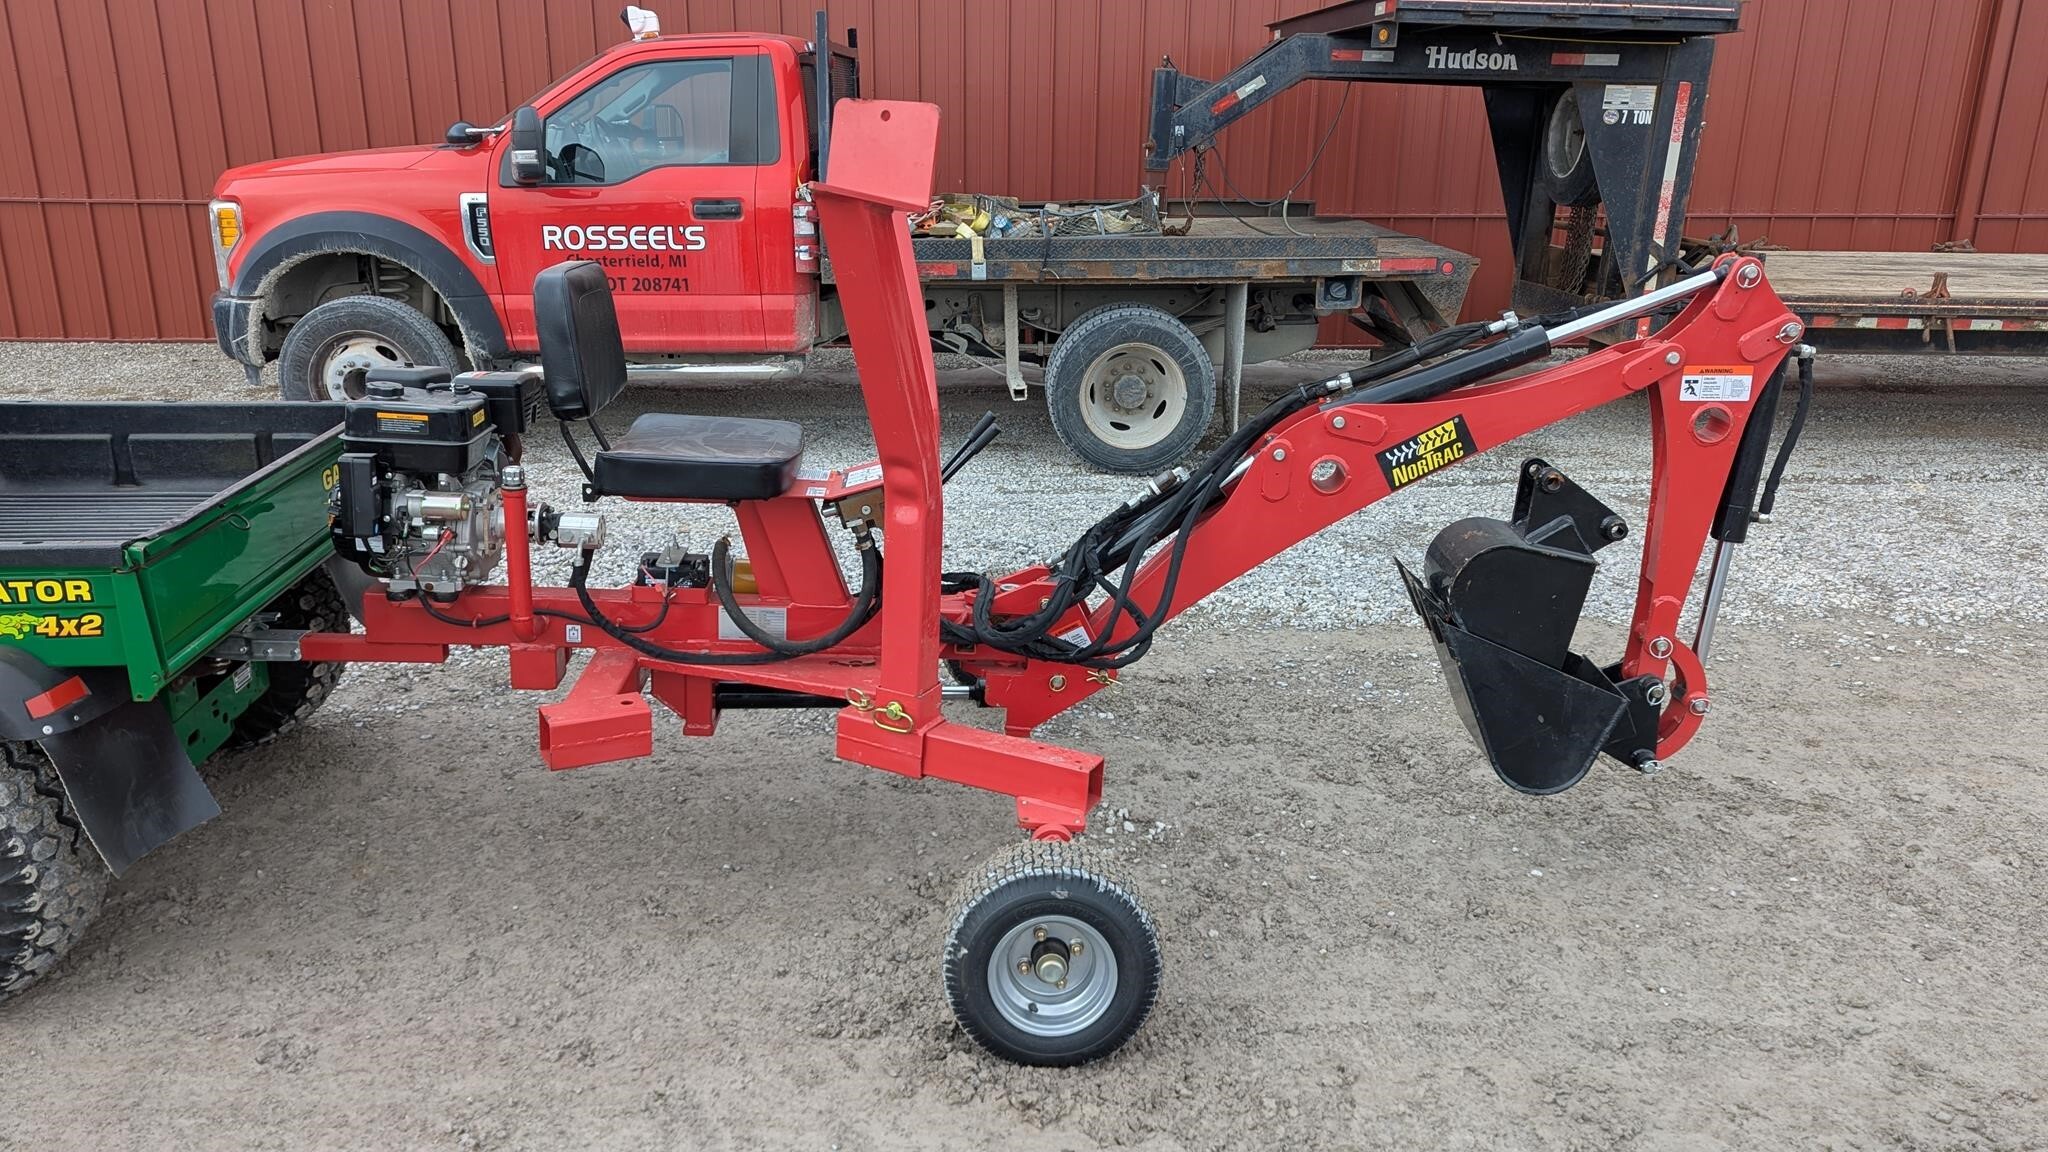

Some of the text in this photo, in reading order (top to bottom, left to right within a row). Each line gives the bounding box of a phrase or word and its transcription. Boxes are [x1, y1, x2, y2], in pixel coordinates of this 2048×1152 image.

[1425, 46, 1518, 70] Hudson
[1621, 110, 1628, 124] 7
[1633, 110, 1653, 125] TON
[542, 225, 706, 250] ROSSEEL'S
[668, 255, 687, 267] MI
[632, 278, 689, 292] 208741
[36, 614, 102, 637] 4x2
